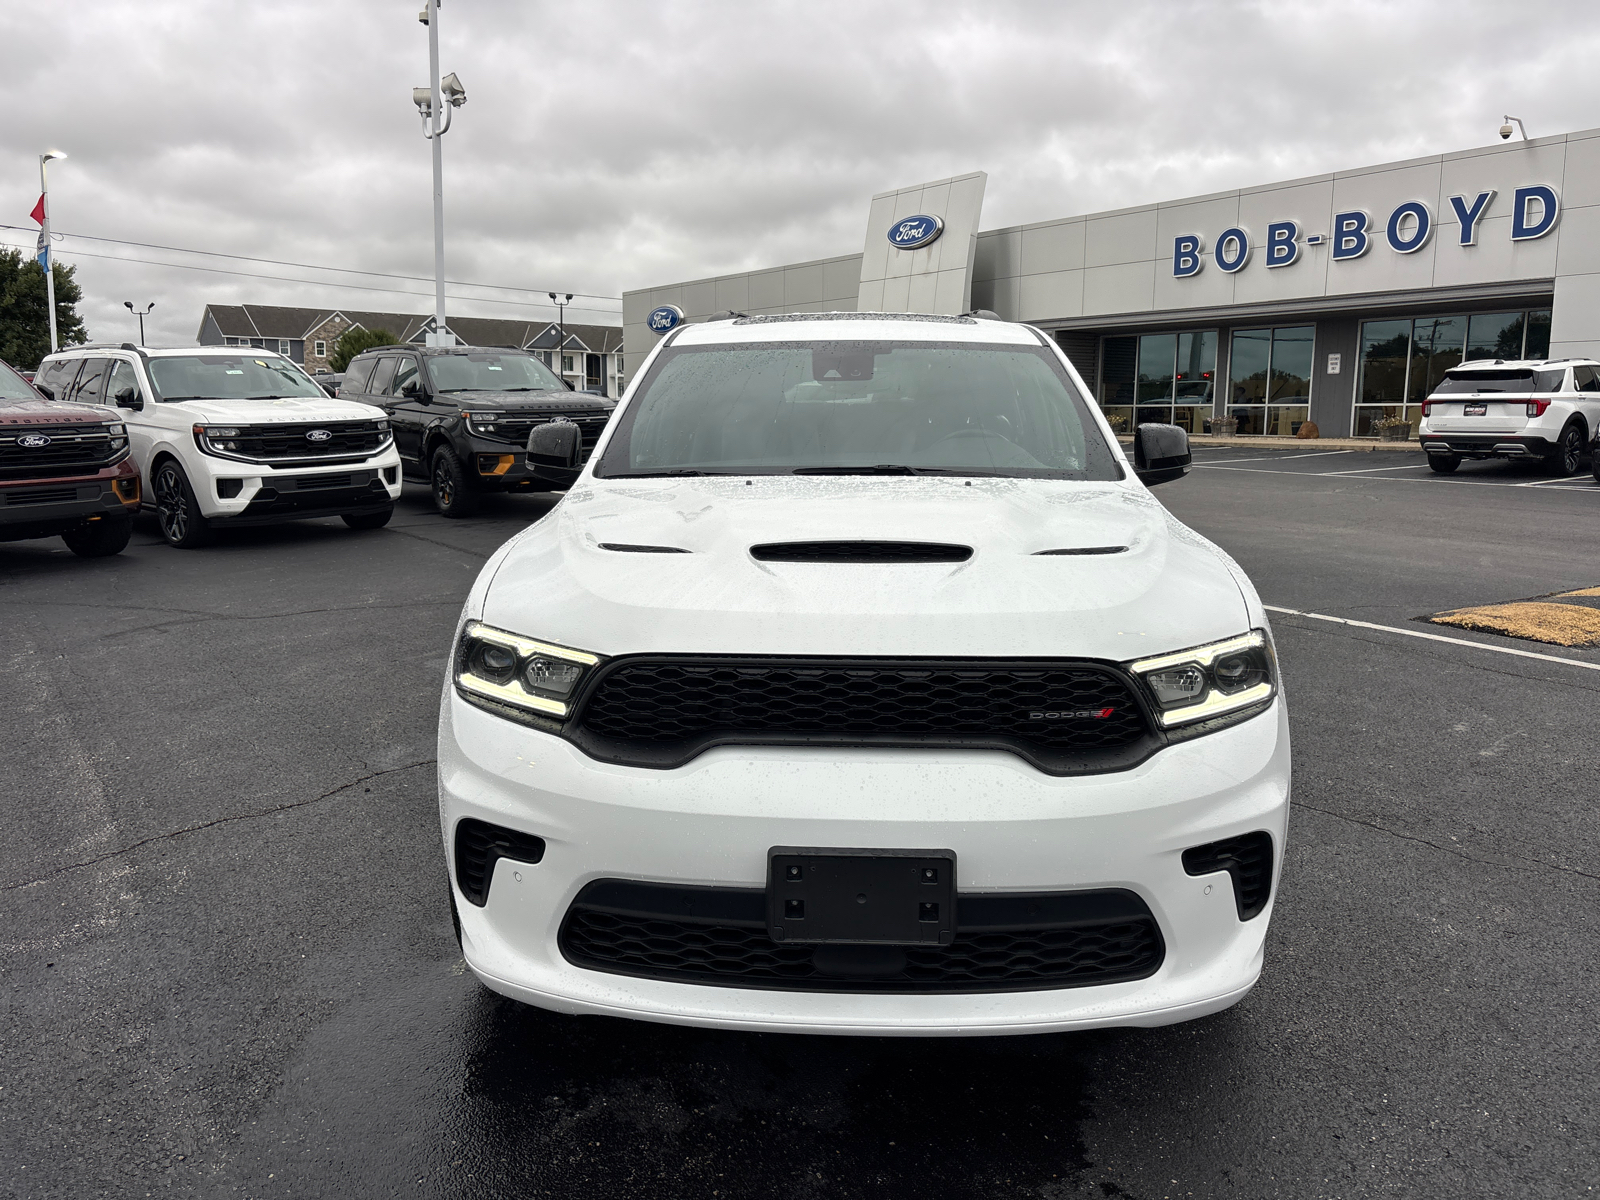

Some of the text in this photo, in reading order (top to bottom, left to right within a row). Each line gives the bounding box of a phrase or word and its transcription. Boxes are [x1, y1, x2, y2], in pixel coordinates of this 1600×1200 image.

[895, 220, 926, 241] Ford
[1172, 184, 1560, 278] BOB-BOYD
[651, 311, 672, 328] Ford
[24, 436, 45, 445] Ford
[1029, 709, 1103, 719] DODGE
